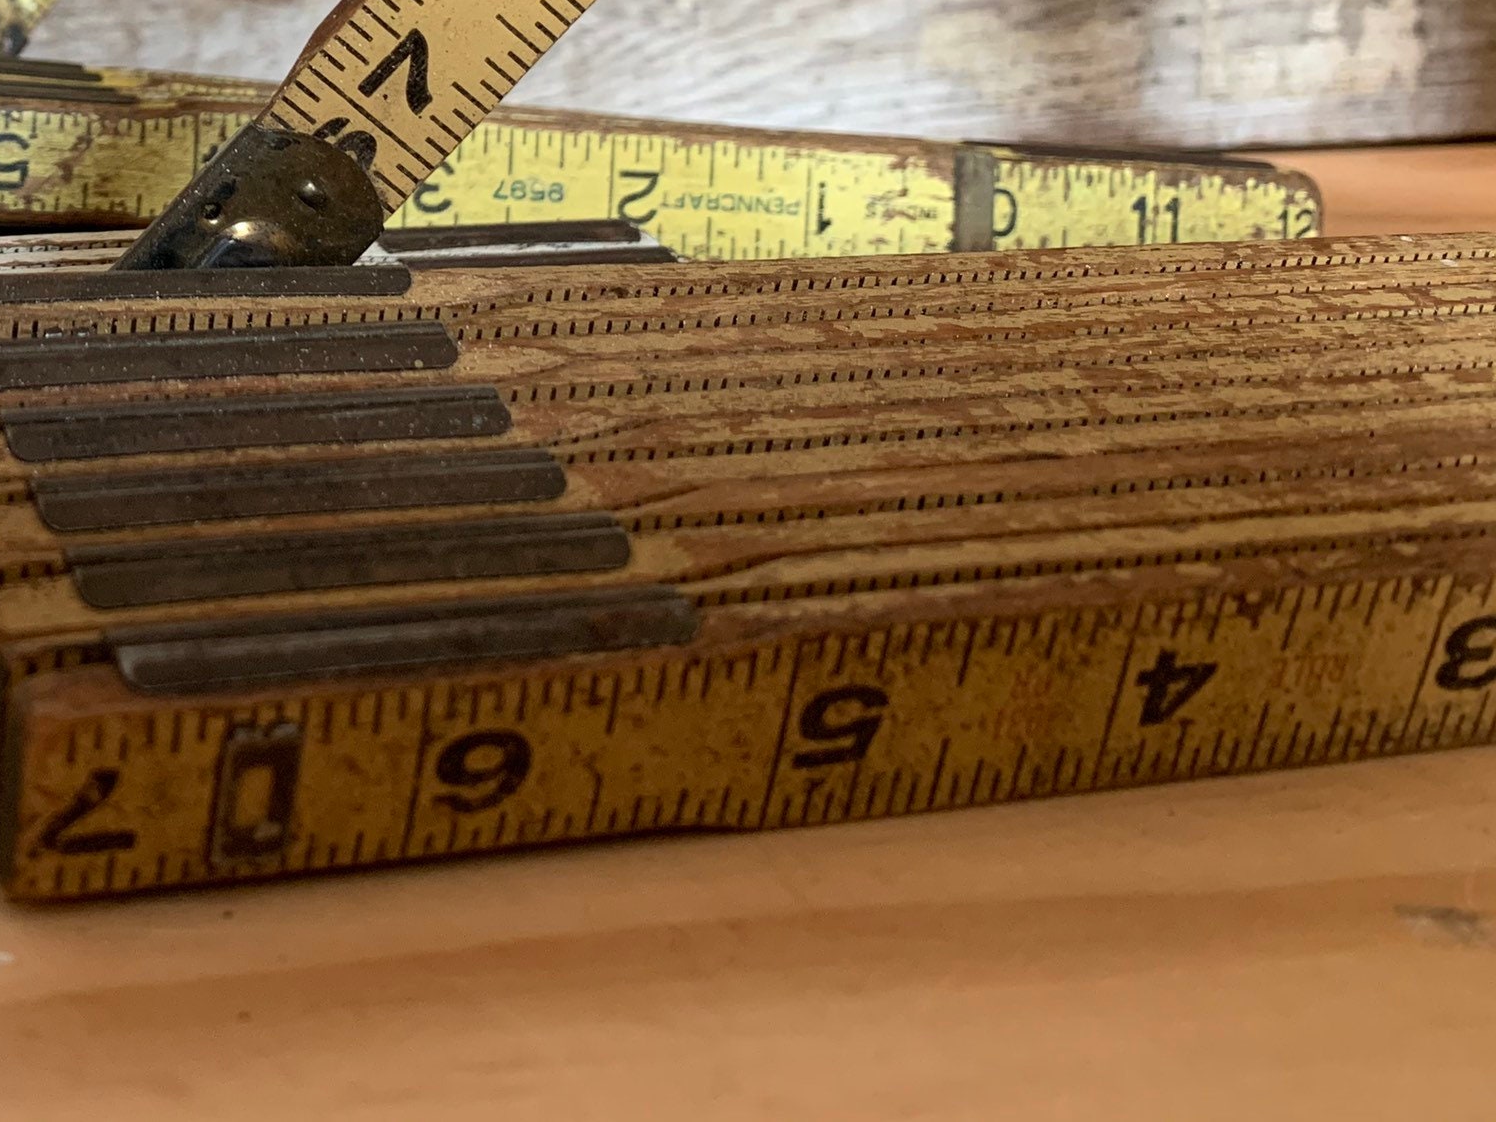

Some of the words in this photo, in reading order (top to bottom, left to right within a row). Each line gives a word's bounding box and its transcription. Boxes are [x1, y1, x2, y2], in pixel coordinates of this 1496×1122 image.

[617, 169, 661, 224] 2
[660, 191, 801, 217] PENNCRAFT
[792, 684, 890, 770] 5
[1136, 649, 1221, 727] 4
[38, 768, 136, 856] 7
